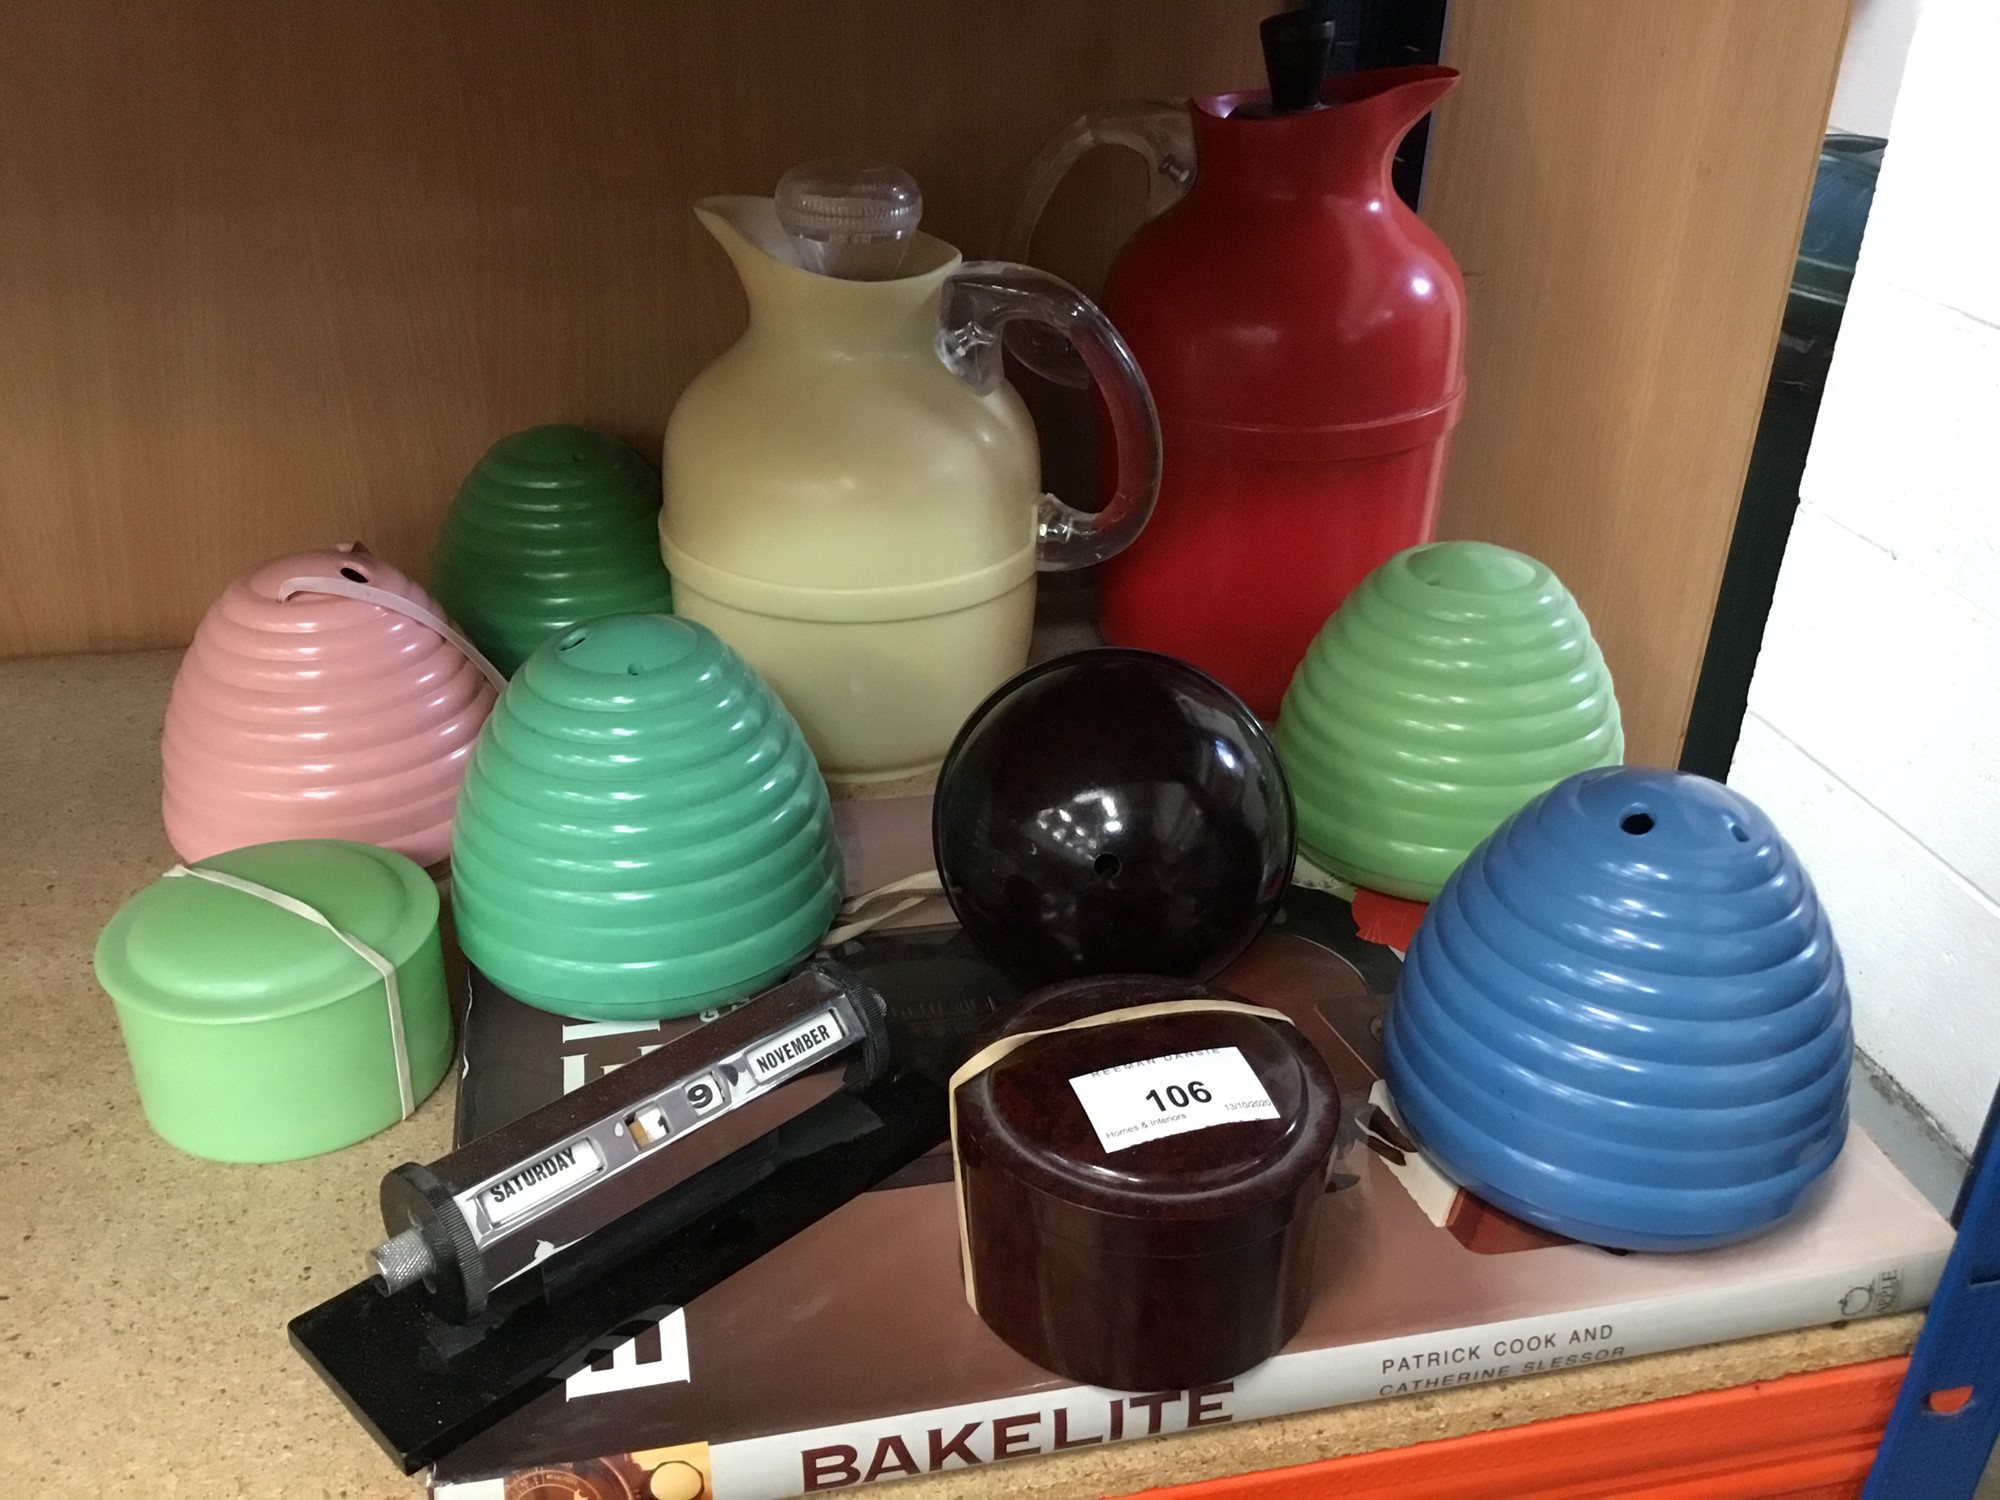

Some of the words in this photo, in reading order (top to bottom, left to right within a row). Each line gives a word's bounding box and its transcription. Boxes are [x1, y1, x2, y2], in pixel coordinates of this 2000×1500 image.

[490, 1147, 577, 1203] SATURDAY
[687, 1083, 713, 1109] 9
[756, 1024, 831, 1074] NOVEMBER
[1145, 1080, 1213, 1112] 106
[1105, 1124, 1140, 1140] Homes
[1141, 1121, 1149, 1130] &
[1150, 1112, 1187, 1128] Interiors
[1379, 1364, 1511, 1396] CATHERINE
[1522, 1346, 1626, 1376] SLESSOR
[1382, 1345, 1481, 1375] PATRICK
[1493, 1332, 1557, 1357] COOK
[1569, 1324, 1613, 1345] AND
[801, 1381, 1234, 1493] BAKELITE
